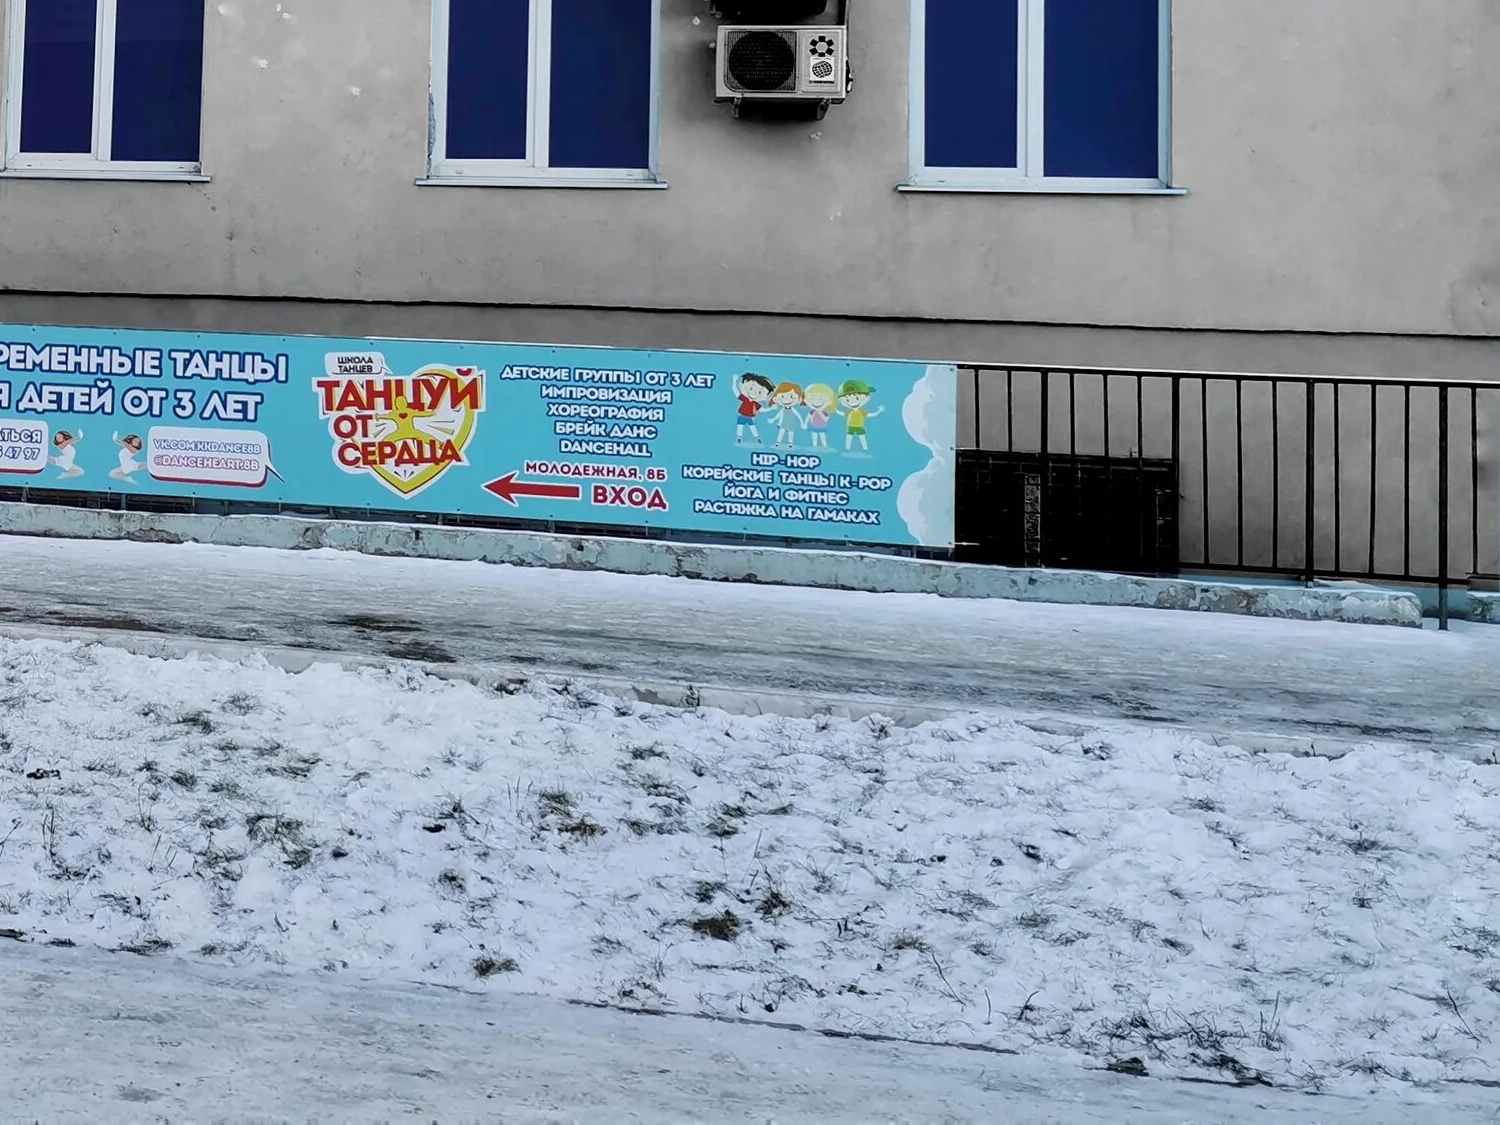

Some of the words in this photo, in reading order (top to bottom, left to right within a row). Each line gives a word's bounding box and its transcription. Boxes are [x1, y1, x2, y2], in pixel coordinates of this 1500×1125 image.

[169, 350, 288, 383] ТАНЦЫ
[337, 356, 373, 364] ШКОЛА
[338, 365, 373, 373] ТАНЦЕВ
[500, 365, 570, 381] ДЕТСКИЕ
[573, 368, 641, 384] ГРУППЫ
[645, 371, 668, 386] ОТ
[670, 373, 682, 387] 3
[684, 373, 715, 388] ЛЕТ
[317, 368, 479, 411] ТАНЦУЙ
[541, 384, 673, 404] ИМПРОВИЗАЦИЯ
[19, 380, 115, 415] ДЕТЕЙ
[121, 389, 169, 417] ОТ
[173, 391, 196, 418] 3
[200, 393, 264, 422] ЛЕТ
[547, 402, 664, 422] ХОРЕОГРАФИЯ
[333, 415, 373, 438] ОТ
[554, 419, 608, 436] БРЕЙК
[609, 424, 657, 439] ДАНС
[5, 447, 21, 459] 47
[23, 448, 40, 460] 97
[338, 439, 462, 466] СЕРДЦА
[559, 439, 652, 458] DANCEHALL
[154, 454, 259, 471] @DANCEHEART.8B
[751, 452, 820, 468] HIP-HOP
[526, 461, 642, 481] МОЛОДЕЖНАЯ,
[646, 469, 666, 481] 8Б
[682, 464, 774, 483] КОРЕЙСКИЕ
[779, 471, 836, 487] ТАНЦЫ
[593, 485, 667, 510] ВХОД
[723, 482, 765, 500] ЙОГА
[768, 488, 780, 501] И
[783, 489, 849, 505] ФИТНЕС
[693, 500, 778, 518] РАСТЯЖКА
[780, 506, 804, 520] НА
[807, 507, 880, 525] ГАМАКАХ
